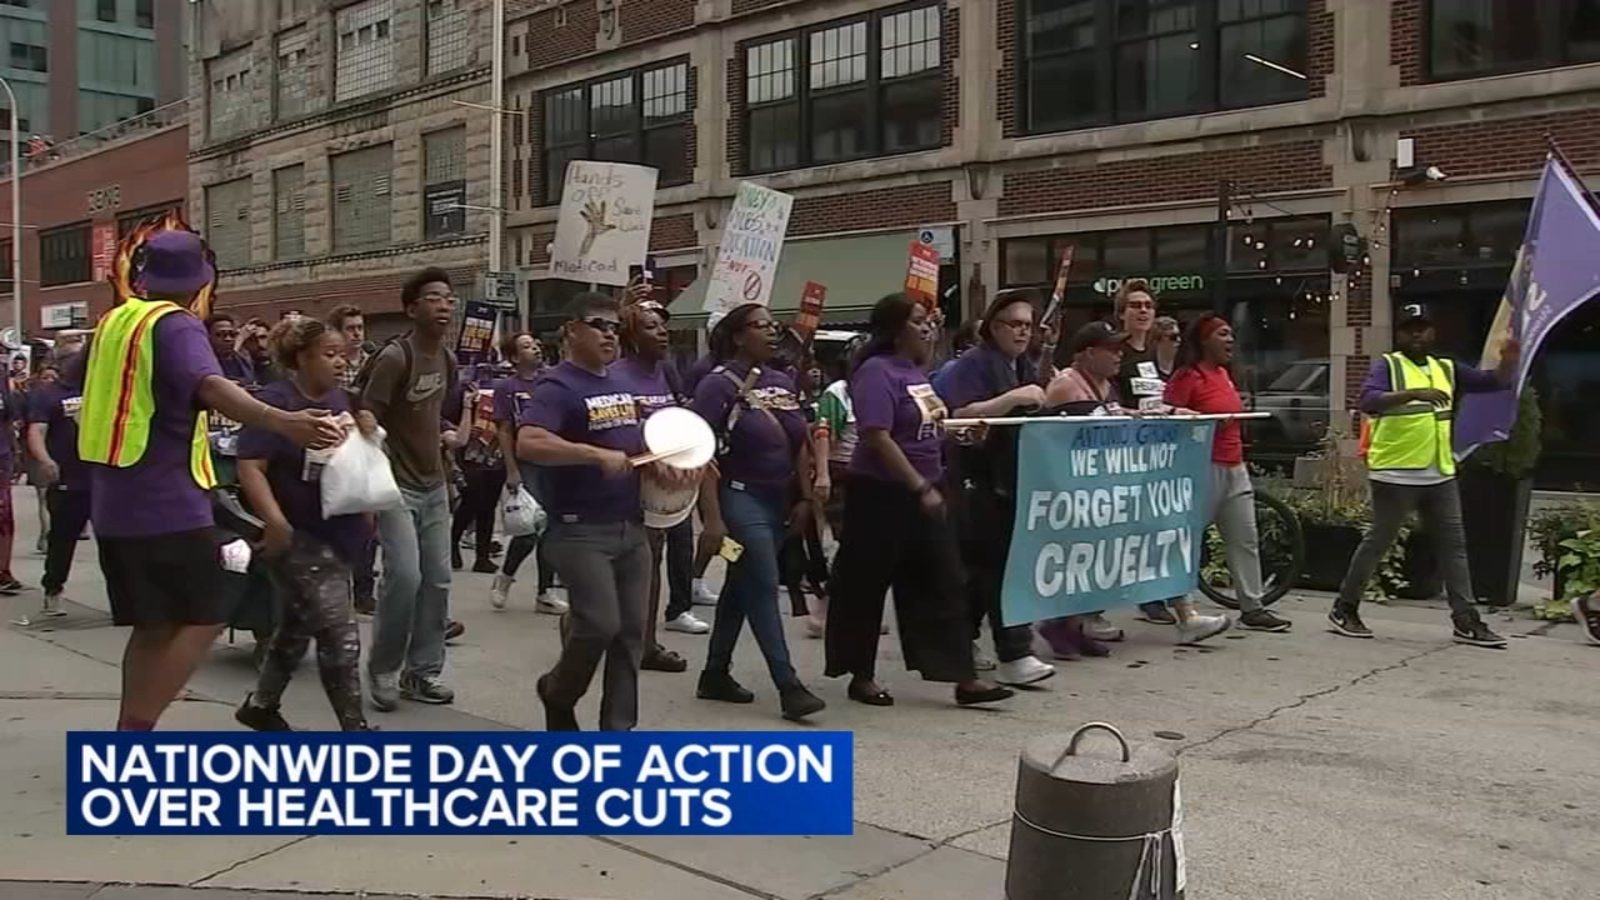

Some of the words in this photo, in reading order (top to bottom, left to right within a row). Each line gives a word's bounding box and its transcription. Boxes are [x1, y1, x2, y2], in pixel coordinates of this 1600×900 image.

[1071, 448, 1098, 477] WE
[1104, 445, 1148, 475] WILL
[1149, 443, 1178, 470] NOT
[1027, 484, 1143, 531] FORGET
[1146, 477, 1193, 519] YOUR
[1034, 527, 1193, 598] CRUELTY
